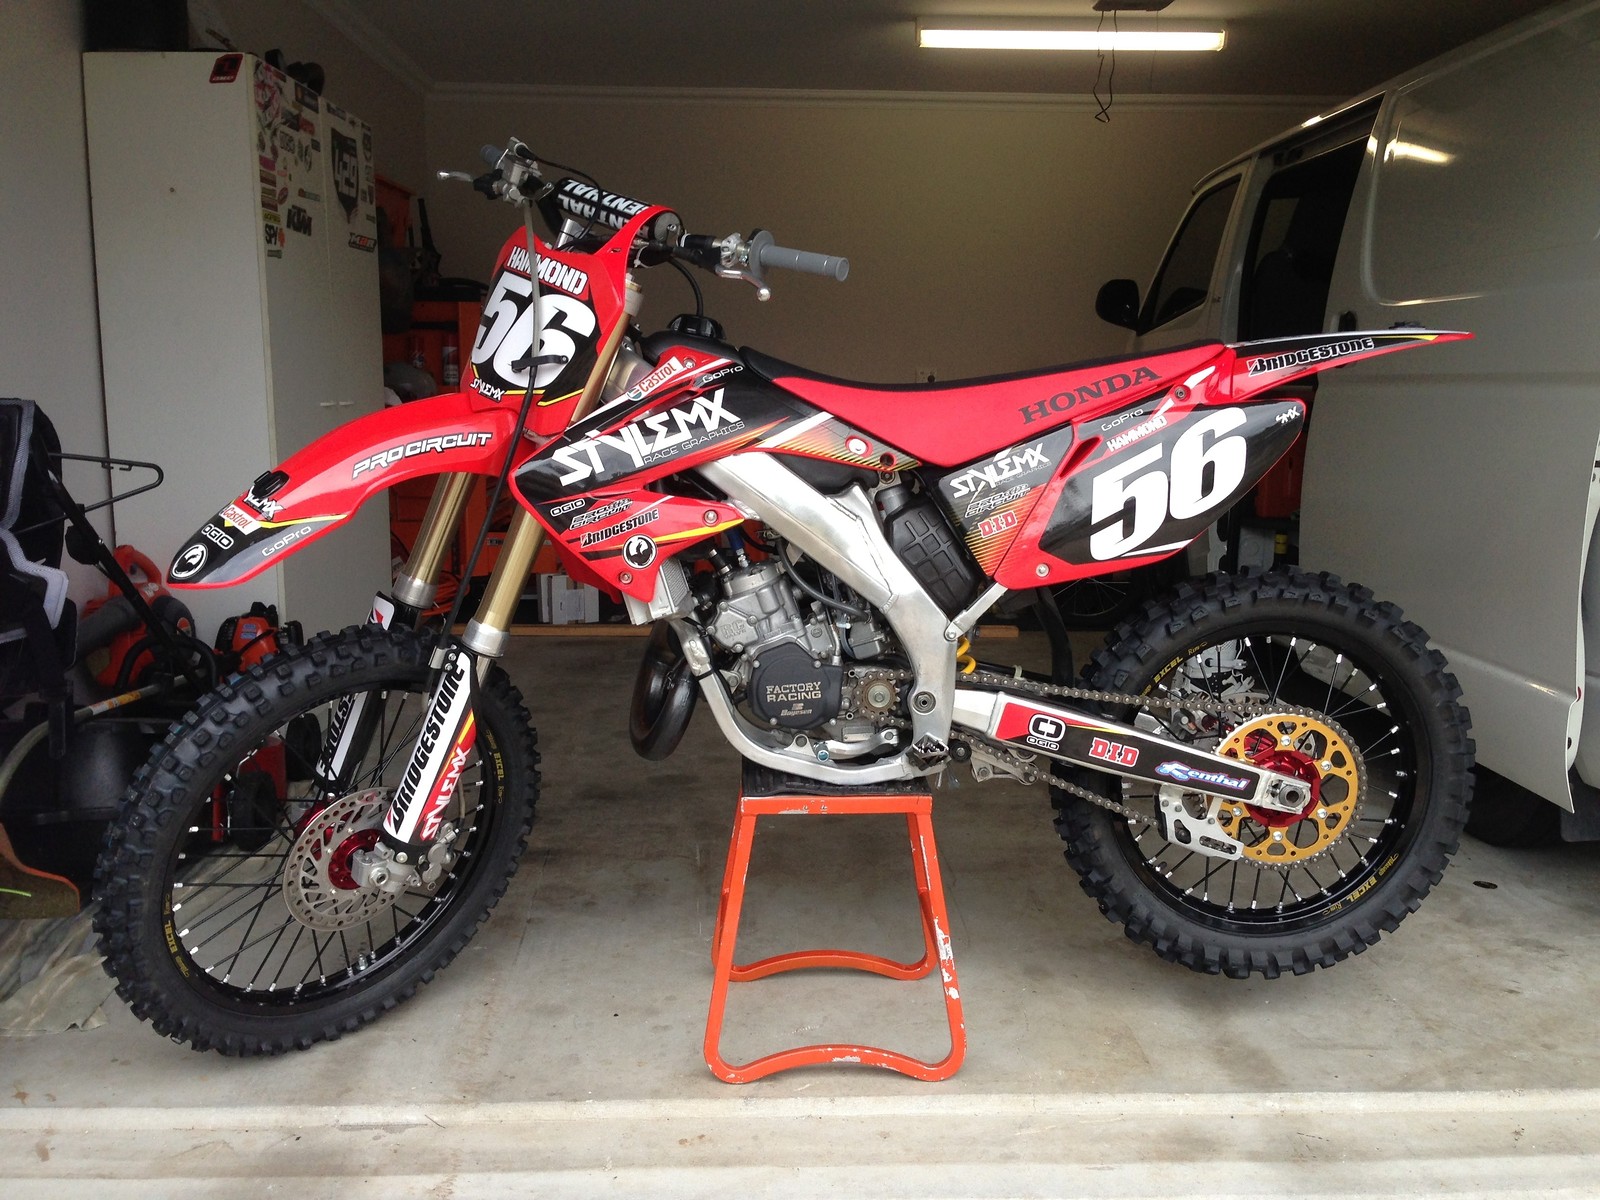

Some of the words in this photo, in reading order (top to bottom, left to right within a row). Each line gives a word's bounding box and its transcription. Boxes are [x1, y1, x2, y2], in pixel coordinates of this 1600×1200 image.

[563, 180, 649, 215] ENTHAL
[507, 245, 589, 297] HAMMOND
[472, 270, 597, 389] 56
[1246, 336, 1375, 377] BRIDGESTONE
[639, 362, 677, 394] Castrol
[702, 364, 744, 384] GoPro
[1018, 366, 1162, 426] HONDA
[1101, 406, 1144, 432] GoPro
[1106, 414, 1168, 452] HAMMOND
[551, 387, 742, 487] STYLEMX
[643, 447, 679, 466] RACE
[682, 420, 745, 451] GRAPHICS
[949, 443, 1050, 499] STYLEMX
[1089, 407, 1248, 561] 56
[223, 506, 252, 529] Castrol
[551, 499, 585, 516] OGIO
[202, 523, 234, 549] OGIO
[261, 526, 311, 556] GoPro
[580, 509, 659, 547] BRIDGESTONE
[1153, 656, 1183, 684] EXCEL
[766, 682, 821, 695] FACTORY
[766, 690, 821, 702] RACING
[385, 664, 465, 835] BRIDGESTONE
[1026, 735, 1059, 751] OGIO
[493, 752, 505, 781] EXCEL
[1154, 761, 1251, 790] Renthal
[1347, 876, 1378, 902] EXCEL
[164, 920, 178, 953] EXCEL
